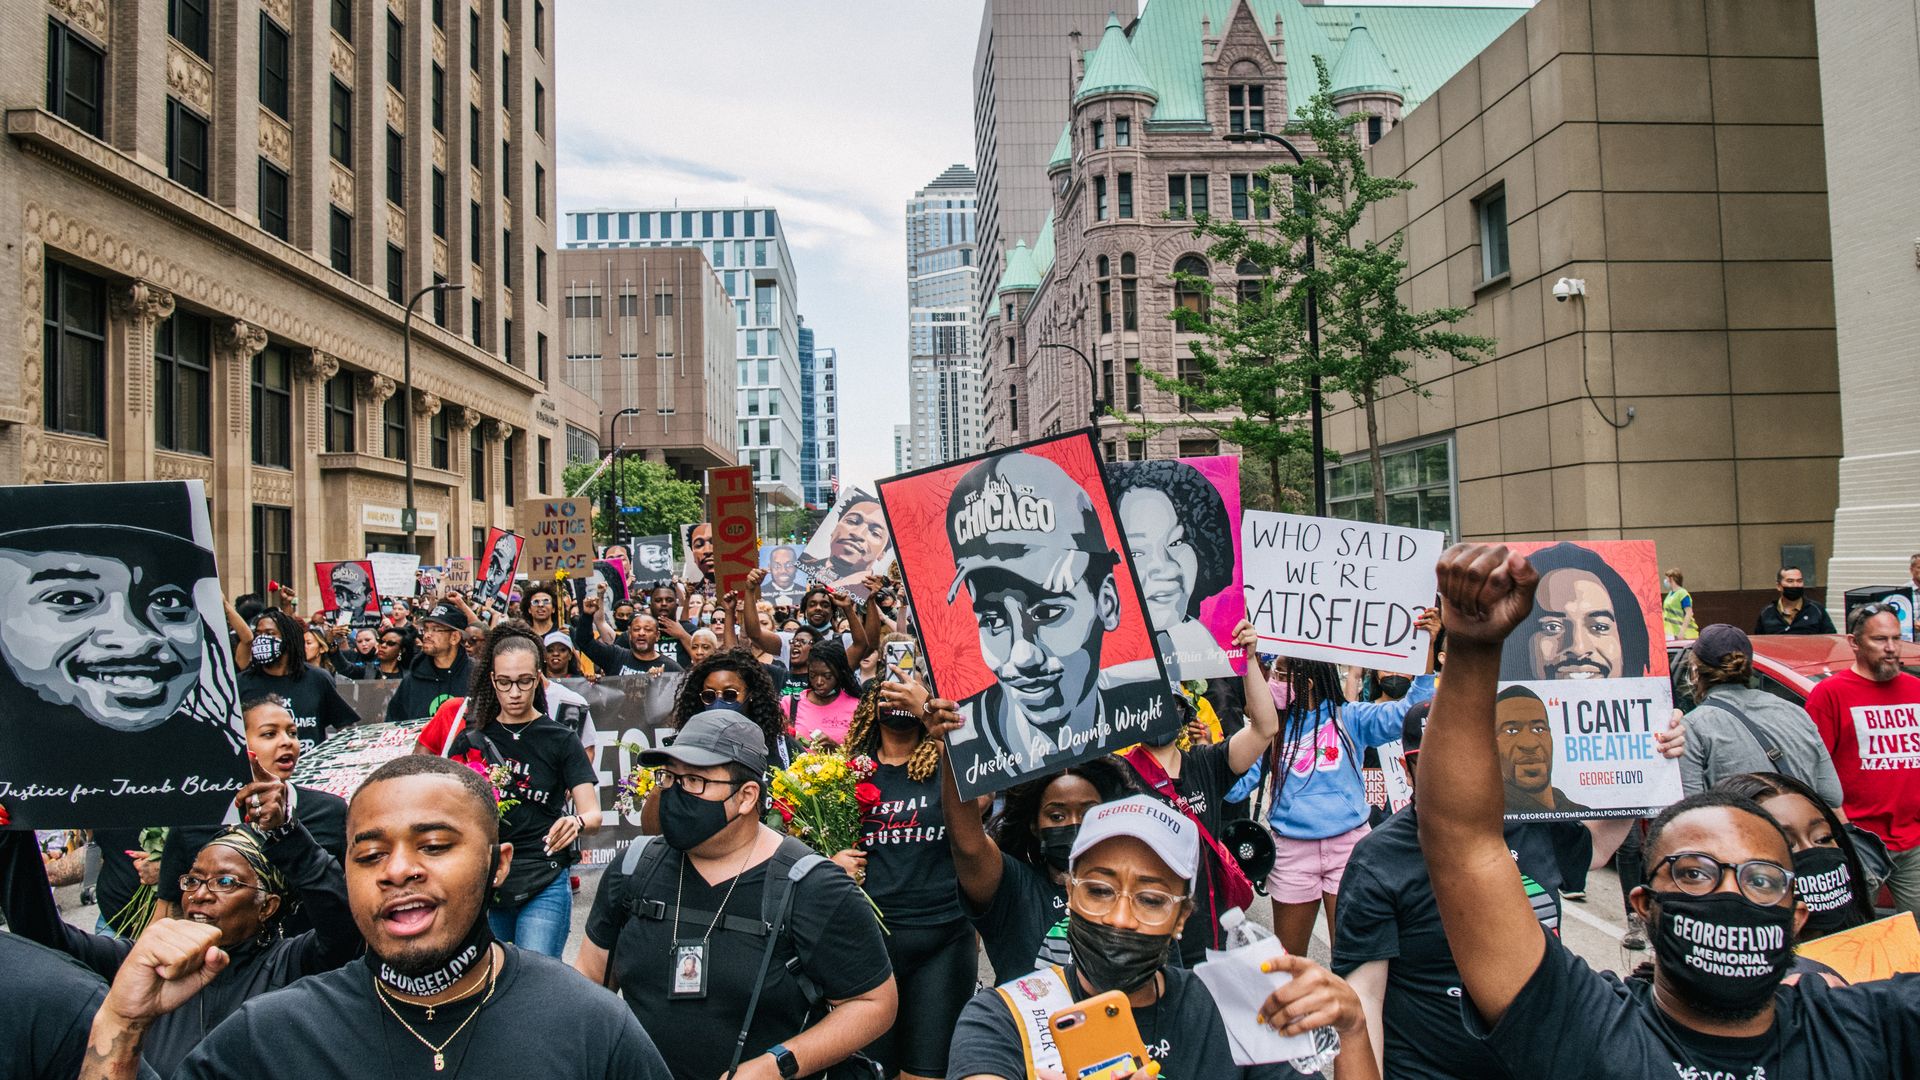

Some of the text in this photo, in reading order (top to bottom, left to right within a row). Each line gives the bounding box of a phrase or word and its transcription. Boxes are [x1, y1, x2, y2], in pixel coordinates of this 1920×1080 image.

[544, 502, 576, 517] NO
[954, 490, 1056, 545] CHICAGO
[532, 519, 586, 536] JUSTICE
[546, 537, 576, 553] NO
[1253, 520, 1417, 562] WHO SAID
[532, 554, 587, 571] PEACE
[1286, 560, 1378, 591] WE'RE
[653, 642, 677, 652] ACK
[892, 709, 916, 718] JUSTI
[1577, 699, 1652, 734] CAN'T
[1864, 708, 1919, 729] BLACK
[966, 695, 1163, 785] Justice for Daunte Wright
[1869, 733, 1920, 755] LIVES
[1860, 757, 1920, 770] MATTE
[0, 775, 247, 803] Justice for Jacob Blake
[872, 796, 928, 815] ISUAL
[865, 826, 946, 847] JUSTICE
[1806, 891, 1853, 912] OUNDATION
[1673, 915, 1784, 952] GEORGEFLOYD
[1693, 945, 1769, 965] MEMORIAL
[1685, 955, 1774, 977] FOUNDATION
[1031, 1008, 1057, 1052] BLACK
